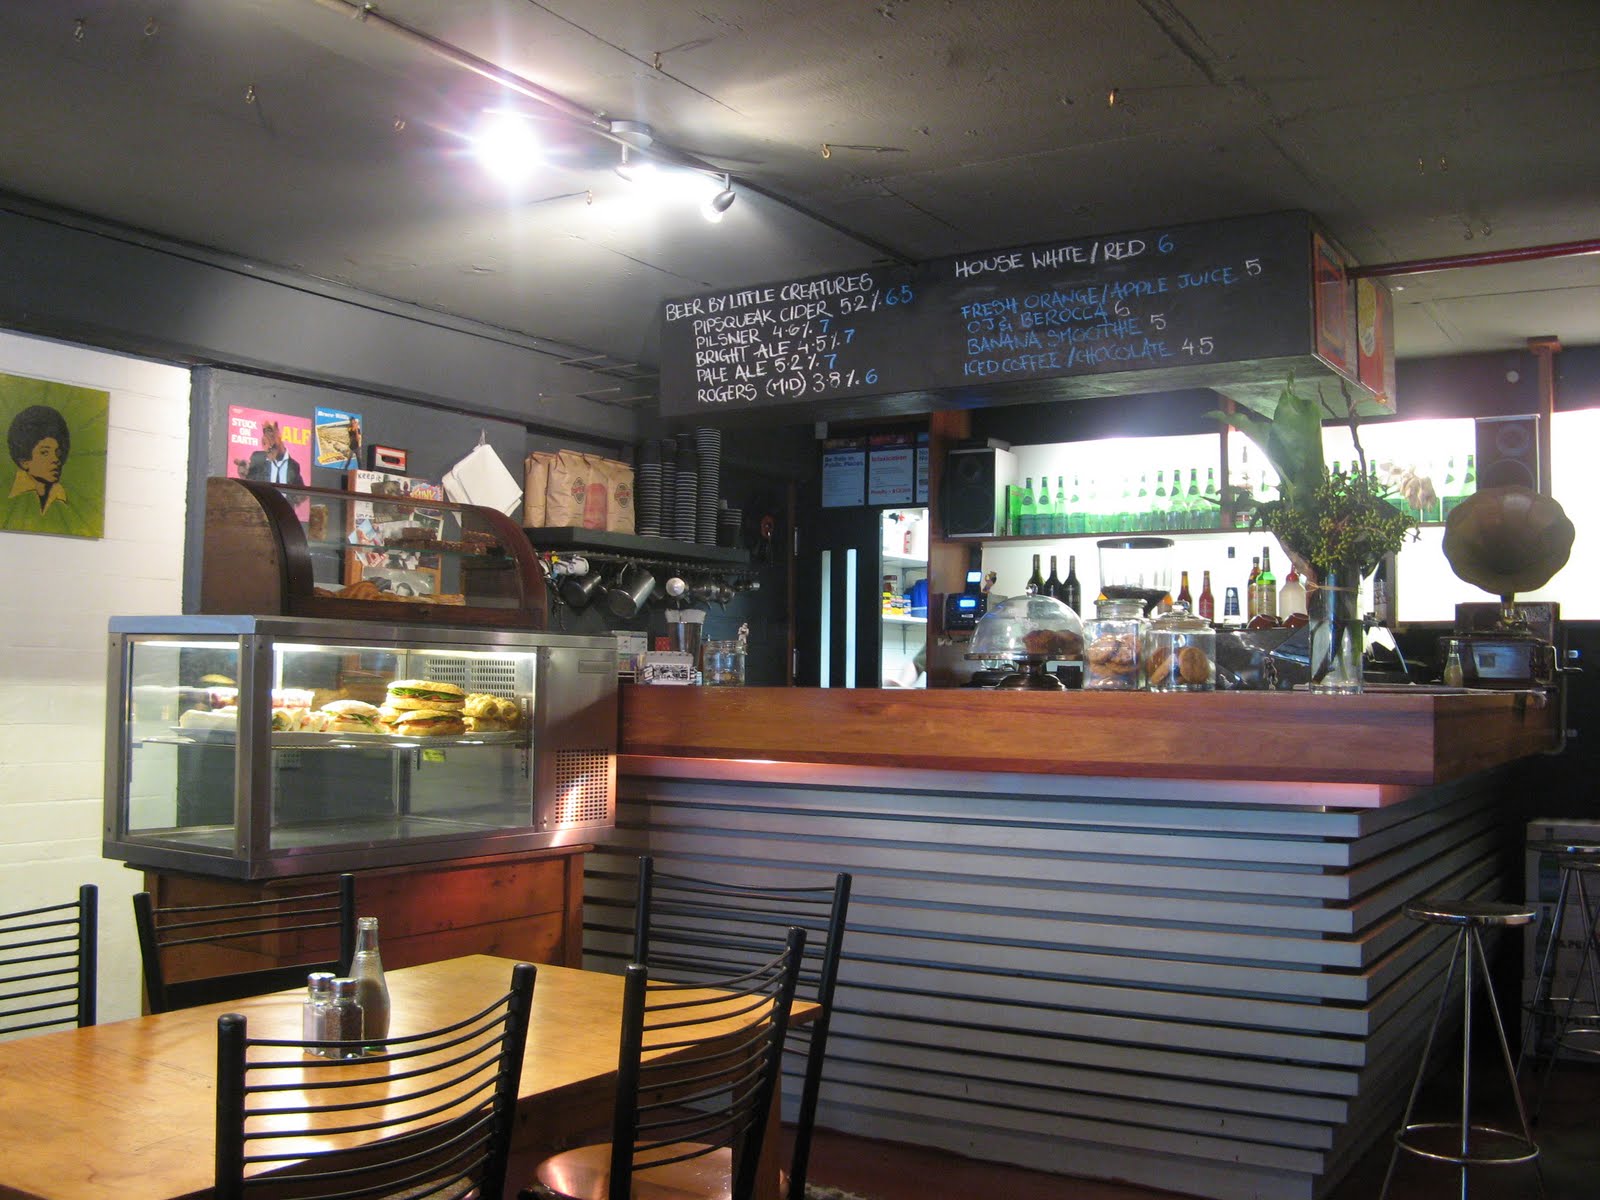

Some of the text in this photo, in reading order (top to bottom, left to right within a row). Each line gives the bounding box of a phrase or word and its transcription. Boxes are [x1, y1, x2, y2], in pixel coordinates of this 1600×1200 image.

[956, 254, 1024, 277] HOUSE
[1158, 235, 1174, 252] 6
[666, 273, 873, 321] BEER BY LITTLE CREATURES
[961, 298, 1018, 319] FRESH
[1177, 267, 1238, 288] JUICE
[1245, 259, 1262, 276] 5
[693, 309, 776, 335] PIPSQUEAK
[780, 300, 833, 320] CIDER
[1021, 306, 1108, 328] BEROCCA
[1114, 300, 1130, 316] 6
[696, 328, 761, 349] PILSNER
[819, 320, 830, 332] 7
[696, 347, 750, 367] BRIGHT
[753, 341, 791, 358] ALE
[844, 329, 855, 344] 7
[967, 314, 1166, 355] BANANA SMOOTHIE 5
[697, 367, 727, 388] PALE
[735, 361, 767, 380] ALE
[824, 354, 837, 369] 7
[964, 359, 999, 376] ICED
[697, 384, 757, 402] ROGERS
[766, 372, 806, 397] (MID)
[865, 369, 878, 384] 6
[232, 418, 257, 429] STUCK
[239, 428, 251, 436] ON
[281, 426, 311, 446] ALF
[231, 435, 258, 446] EARTH
